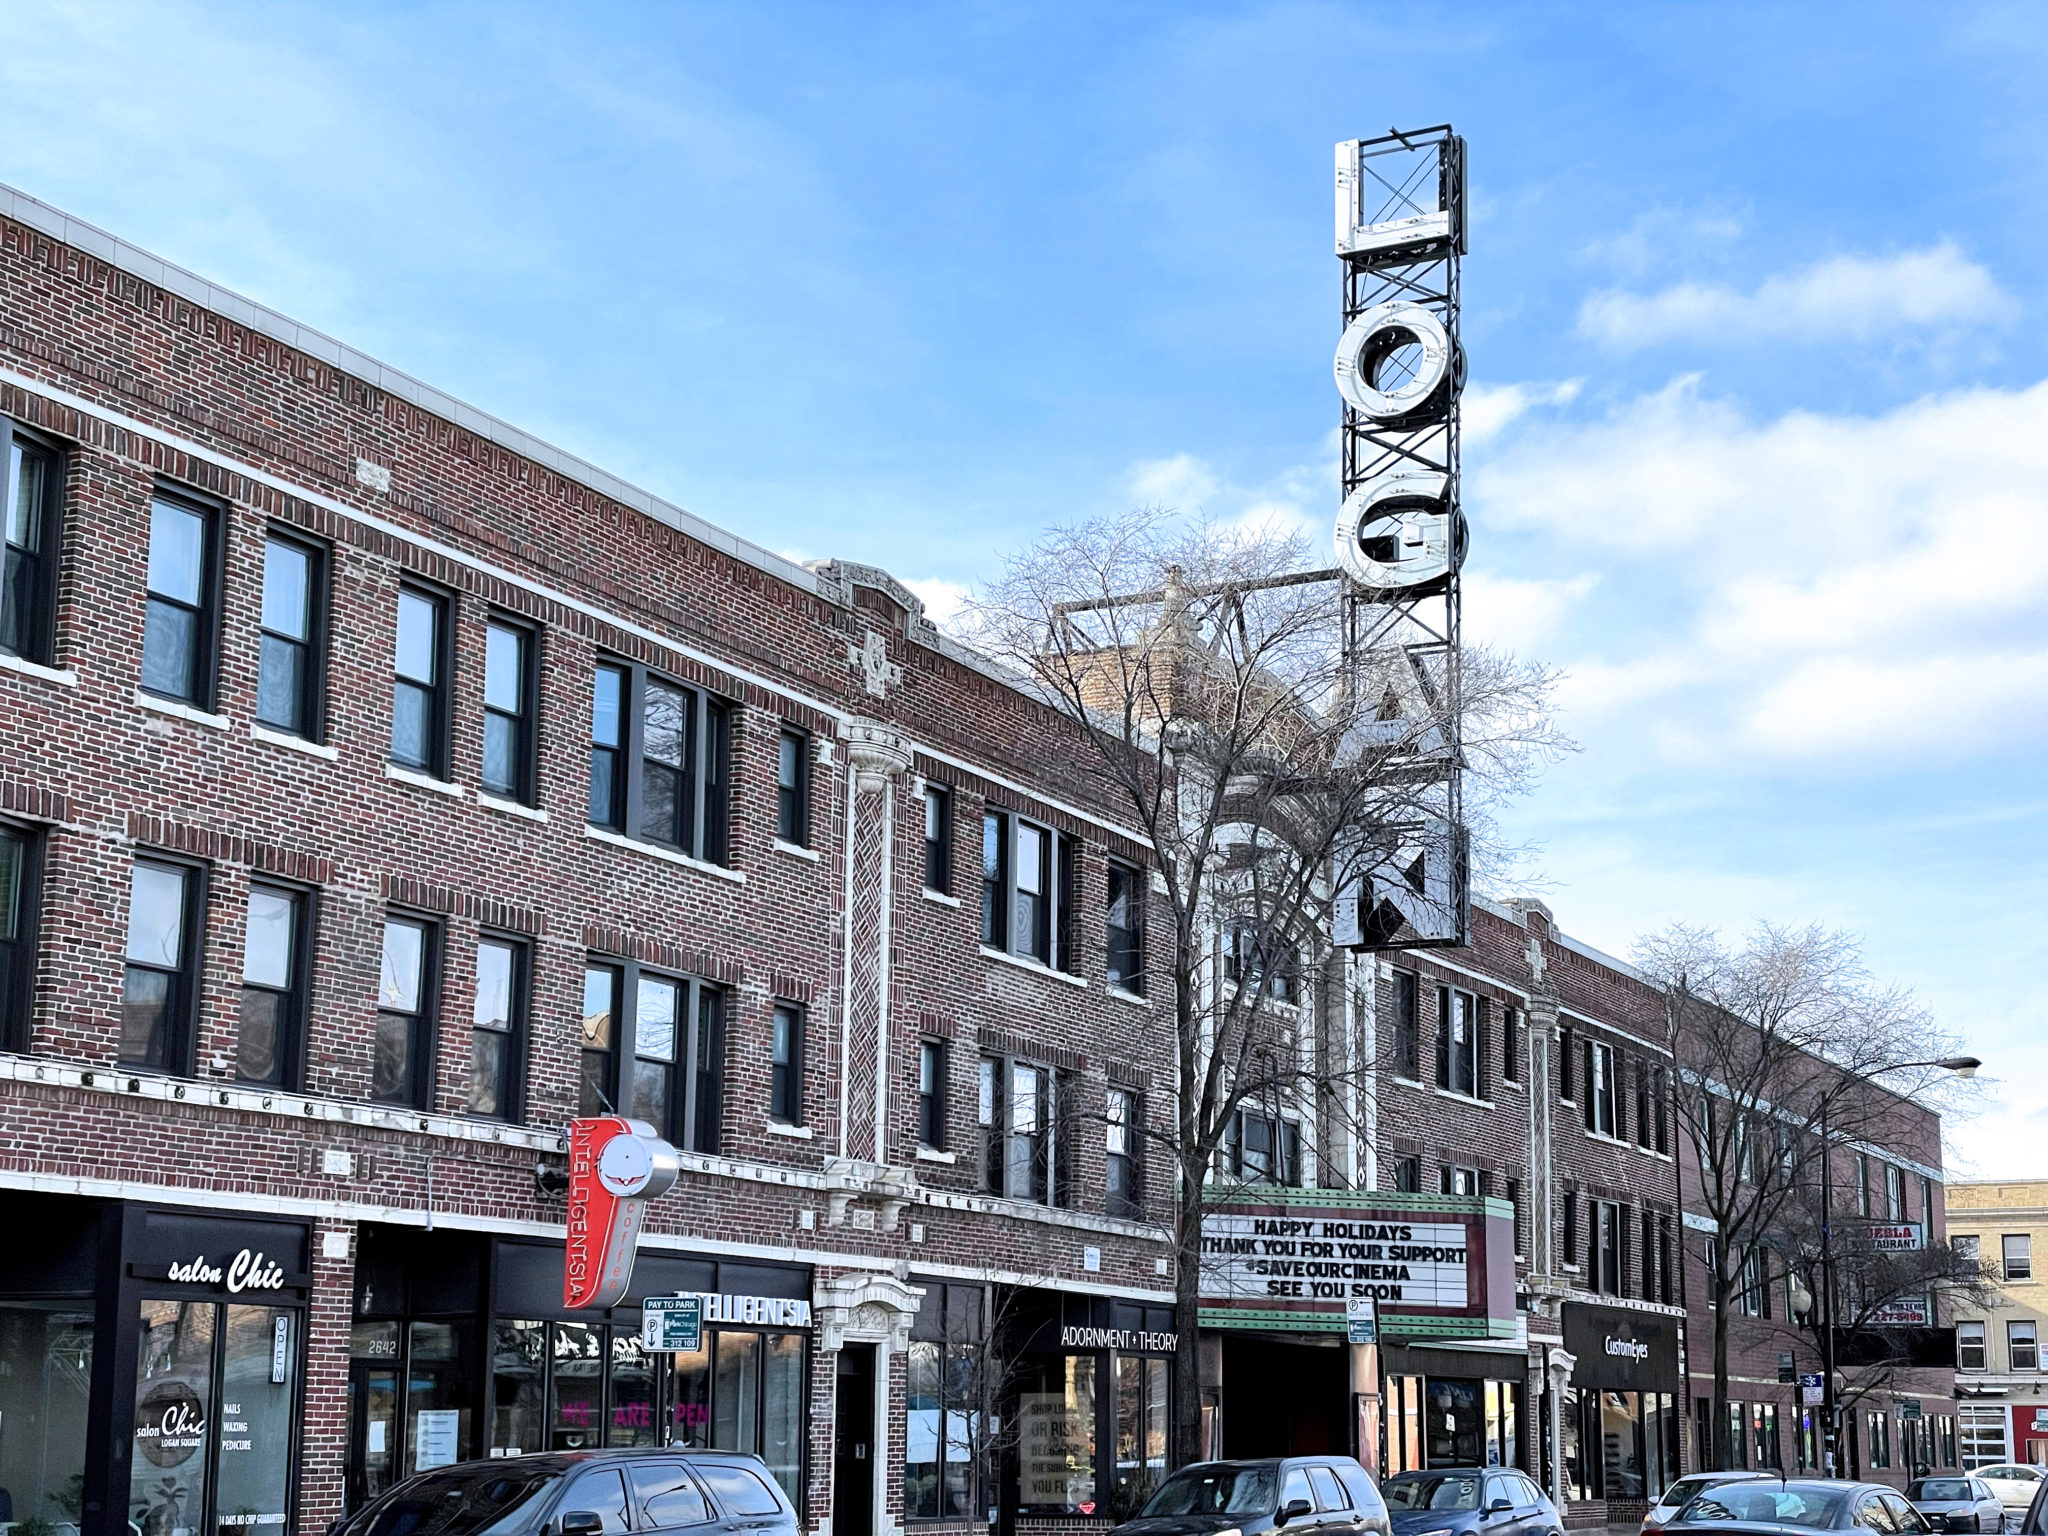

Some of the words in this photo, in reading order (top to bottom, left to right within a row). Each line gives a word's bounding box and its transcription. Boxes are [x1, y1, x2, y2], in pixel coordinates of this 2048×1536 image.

[1334, 137, 1460, 949] LOGAN
[569, 1124, 596, 1297] INTELLIGENTSIA
[1254, 1219, 1314, 1238] HAPPY
[1323, 1222, 1412, 1241] HOLIDAYS
[609, 1202, 636, 1292] coffee
[1201, 1237, 1258, 1255] THANK
[1262, 1240, 1296, 1257] YOU
[1301, 1242, 1334, 1258] FOR
[1339, 1243, 1383, 1260] YOUR
[1389, 1245, 1467, 1264] SUPPORT
[168, 1255, 222, 1283] salon
[227, 1249, 284, 1293] Chic
[1267, 1280, 1303, 1298] SEE
[1310, 1282, 1346, 1298] YOU
[1351, 1283, 1402, 1300] SOON
[648, 1300, 662, 1309] PAY
[663, 1300, 674, 1309] TO
[675, 1300, 695, 1309] PARK
[368, 1340, 396, 1354] 2642
[1061, 1326, 1131, 1348] ADORNMENT
[1138, 1331, 1179, 1351] THEORY
[274, 1318, 286, 1382] OPEN
[1605, 1335, 1648, 1364] CustomEyes
[223, 1403, 241, 1414] NAILS
[562, 1401, 591, 1427] WE
[614, 1402, 651, 1427] ARE
[674, 1403, 709, 1427] PEN
[1031, 1403, 1052, 1415] SHOP
[136, 1423, 160, 1437] salon
[161, 1402, 206, 1436] Chic
[223, 1422, 248, 1432] WAXING
[1031, 1422, 1048, 1437] OR
[1051, 1422, 1078, 1437] RISK
[161, 1438, 180, 1448] LOGAN
[180, 1438, 202, 1447] SQUARE
[222, 1440, 252, 1450] PEDICURE
[1032, 1463, 1045, 1473] THE
[1032, 1480, 1052, 1494] YOU
